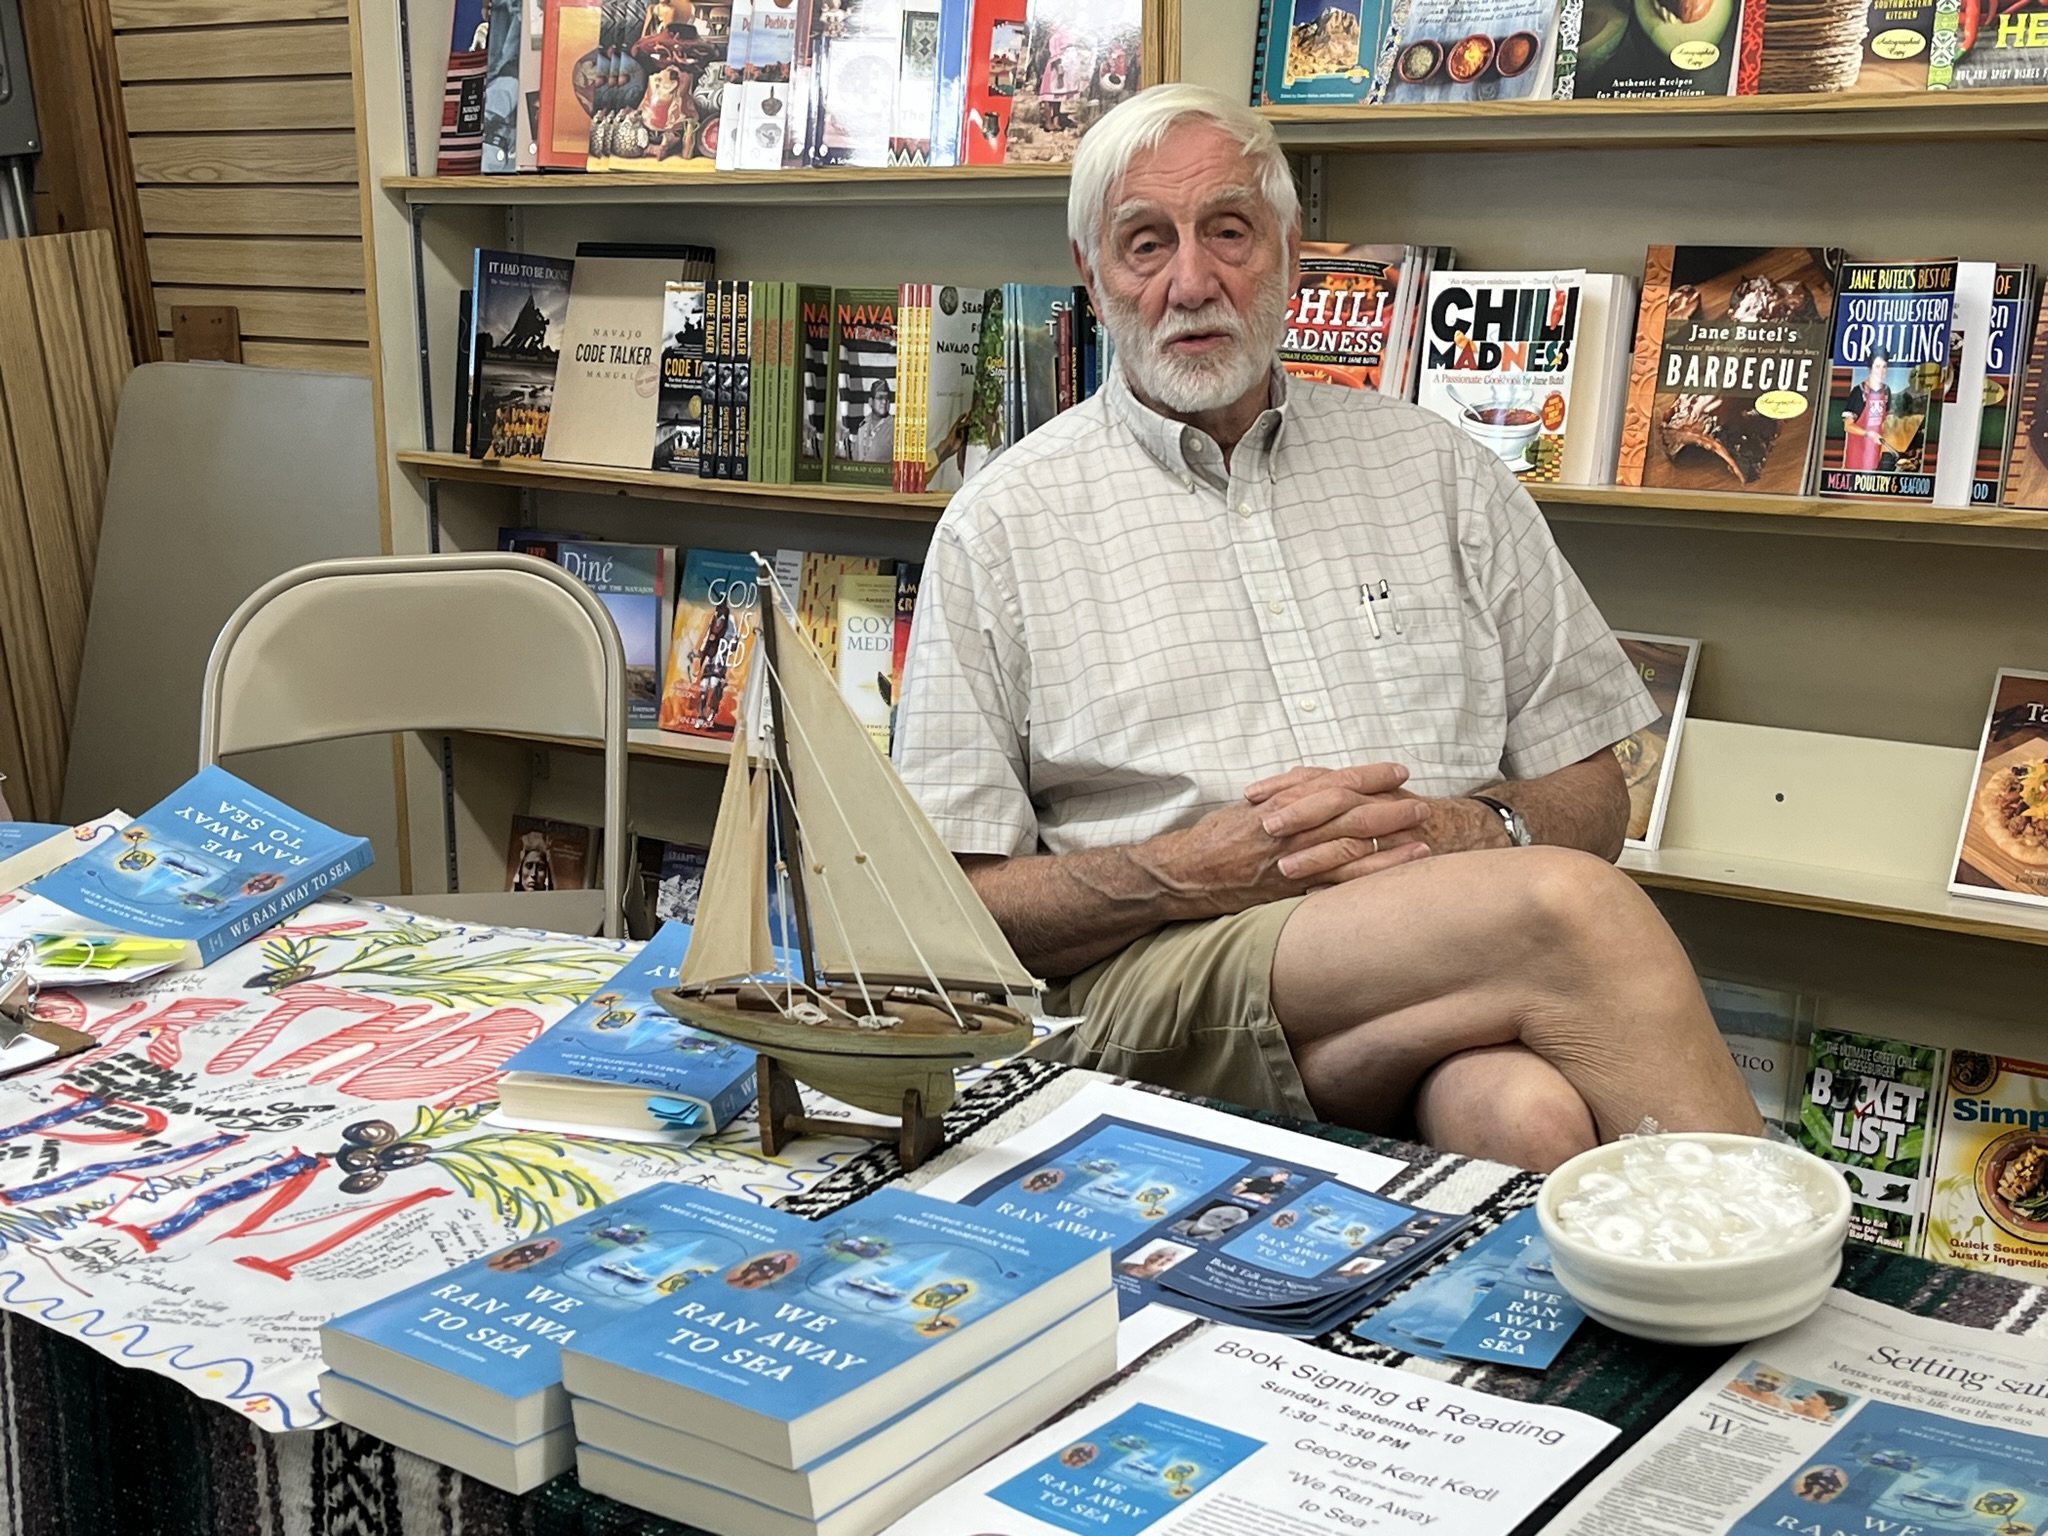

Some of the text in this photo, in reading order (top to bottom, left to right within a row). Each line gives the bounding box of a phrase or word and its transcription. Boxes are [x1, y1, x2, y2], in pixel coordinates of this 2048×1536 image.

[1885, 10, 1919, 20] KITCHEN
[1611, 77, 1694, 88] Authentic Recipes
[1973, 70, 1988, 81] AND
[1990, 69, 2011, 80] SPICY
[2014, 68, 2040, 80] DISHES
[1596, 88, 1706, 99] for Enduring Traditions
[488, 261, 569, 281] IT HAD TO BE DONE
[1849, 267, 1952, 290] JANE BUTEL'S BEST OF
[1994, 275, 2013, 295] OF
[837, 304, 894, 325] NAVA
[1284, 288, 1389, 327] HILI
[1431, 287, 1580, 342] CHILI
[1847, 298, 1949, 323] SOUTHWESTERN
[593, 328, 642, 339] NAVAJO
[704, 292, 716, 354] CODE TALKER
[720, 293, 732, 356] CODE TALKER
[736, 293, 748, 356] CODE TALKER
[1689, 324, 1797, 343] Jane Butel's
[936, 341, 970, 354] NAVAJO
[1282, 328, 1383, 353] ADNESS
[1842, 323, 1945, 363] GRILLING
[575, 343, 652, 365] CODE TALKER
[664, 357, 691, 377] CODE
[1301, 353, 1338, 363] COOKBOOK
[1427, 340, 1571, 372] MADNESS
[586, 370, 635, 381] MANUAL
[1441, 374, 1483, 384] Passionate
[1483, 375, 1521, 384] Cookbook
[1522, 374, 1531, 386] by
[1531, 375, 1548, 385] Jane
[1666, 354, 1813, 392] BARBECUE
[1828, 473, 1931, 494] MEAT, POULTRY & SEAFOOD
[563, 551, 614, 583] Diné
[624, 586, 654, 594] NAVAJOS
[708, 578, 757, 609] GOD
[737, 610, 753, 639] IS
[848, 617, 894, 634] COY
[714, 638, 746, 668] RED
[847, 637, 893, 651] MEDI
[174, 805, 310, 867] RAN AWAY
[217, 800, 305, 850] TO SEA
[200, 838, 244, 864] WE
[230, 860, 352, 938] WE RAN AWAY TO SEA
[1731, 1052, 1774, 1073] XICO
[1825, 1041, 1918, 1070] THE ULTIMATE GREEN CHILE
[1842, 1057, 1896, 1079] CHEESEBURGER
[1830, 1111, 1905, 1159] LIST
[995, 1201, 1116, 1243] RAN AWAY
[1054, 1199, 1095, 1219] WE
[1949, 1237, 1989, 1251] Quick
[1949, 1250, 1978, 1262] Just
[1982, 1252, 1990, 1262] 7
[525, 1285, 584, 1314] WE
[1505, 1301, 1562, 1318] RAN
[1522, 1289, 1562, 1306] WE
[430, 1283, 577, 1345] RAN AWA
[774, 1302, 838, 1333] WE
[1484, 1311, 1565, 1333] AWAY
[418, 1307, 468, 1331] TO
[465, 1327, 532, 1360] SEA
[672, 1301, 760, 1335] RAN
[754, 1331, 867, 1371] AWAY
[1478, 1337, 1526, 1355] SEA
[1498, 1326, 1532, 1341] TO
[666, 1327, 720, 1353] TO
[721, 1348, 793, 1382] SEA
[1866, 1345, 1994, 1392] Setting
[1213, 1340, 1565, 1446] Book Signing & Reading
[1828, 1360, 2048, 1418] Memoir offers an intimate look
[1841, 1377, 2034, 1427] one couple's life on the seas
[1278, 1405, 1317, 1424] 1:30
[1334, 1422, 1376, 1441] 3:30
[1377, 1435, 1411, 1451] PM
[1336, 1403, 1438, 1439] September
[1441, 1432, 1465, 1446] 10
[1294, 1437, 1500, 1503] George Kent Kedl
[1037, 1473, 1087, 1497] RAN
[1086, 1492, 1148, 1519] AWAY
[1092, 1476, 1128, 1496] WE
[1038, 1489, 1069, 1508] TO
[1070, 1502, 1111, 1526] SEA
[1298, 1498, 1320, 1513] to
[1329, 1484, 1374, 1507] Ran
[1375, 1500, 1440, 1528] Away
